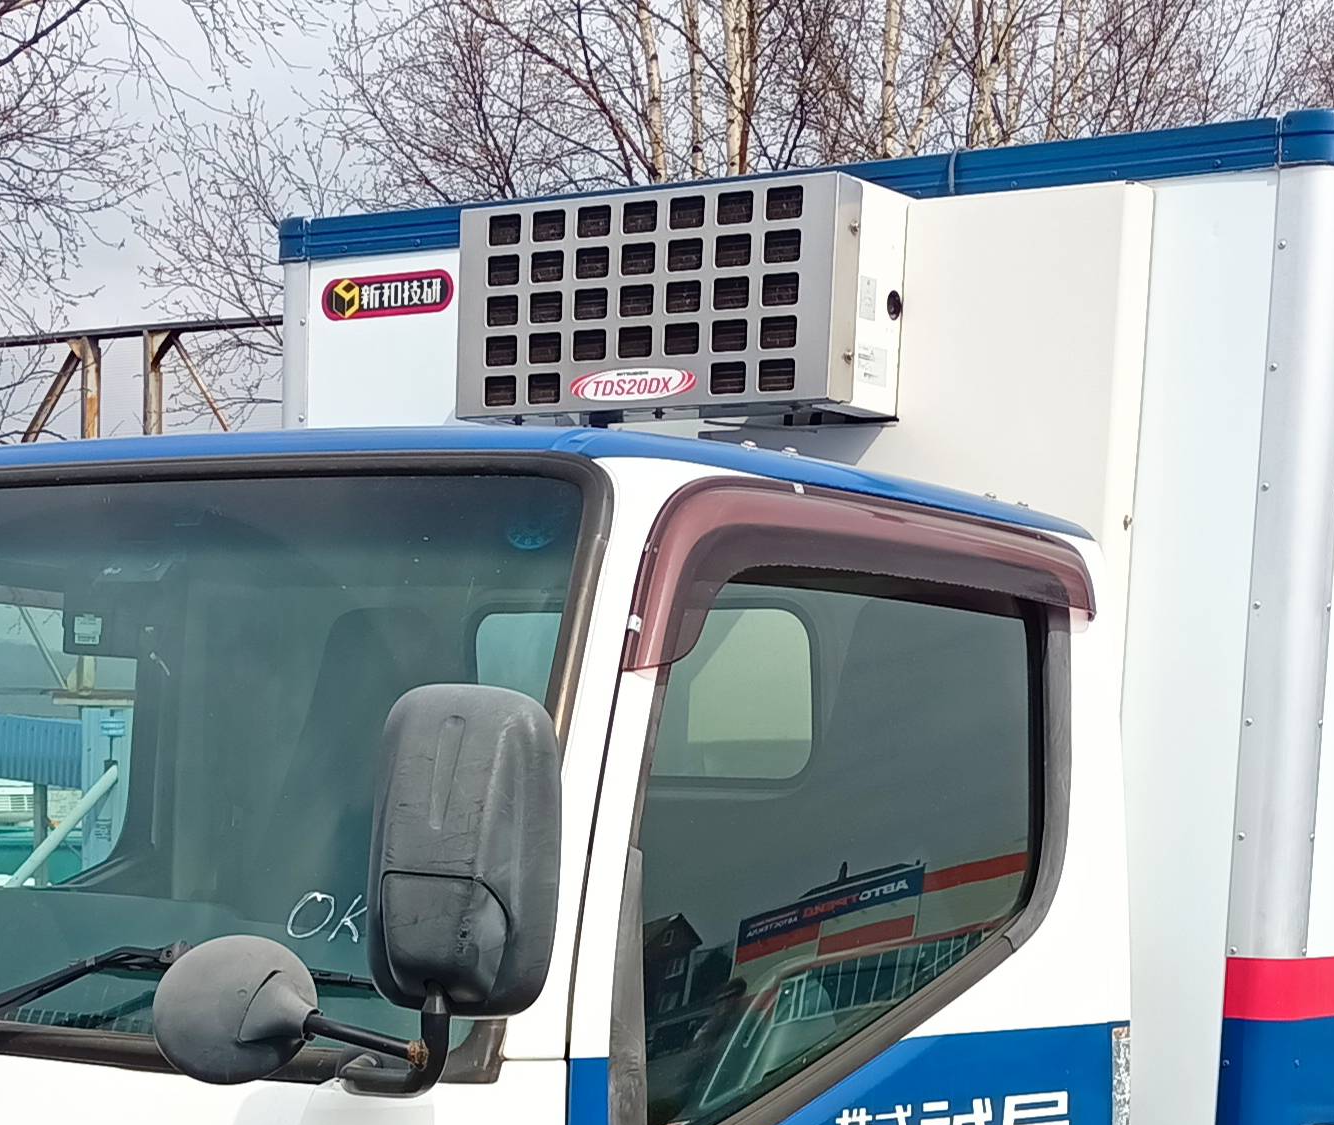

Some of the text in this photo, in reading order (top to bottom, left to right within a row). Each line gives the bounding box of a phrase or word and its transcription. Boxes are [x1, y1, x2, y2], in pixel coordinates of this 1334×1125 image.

[360, 278, 442, 309] 新和技研
[593, 376, 673, 397] TDS20DX
[287, 892, 368, 943] OK
